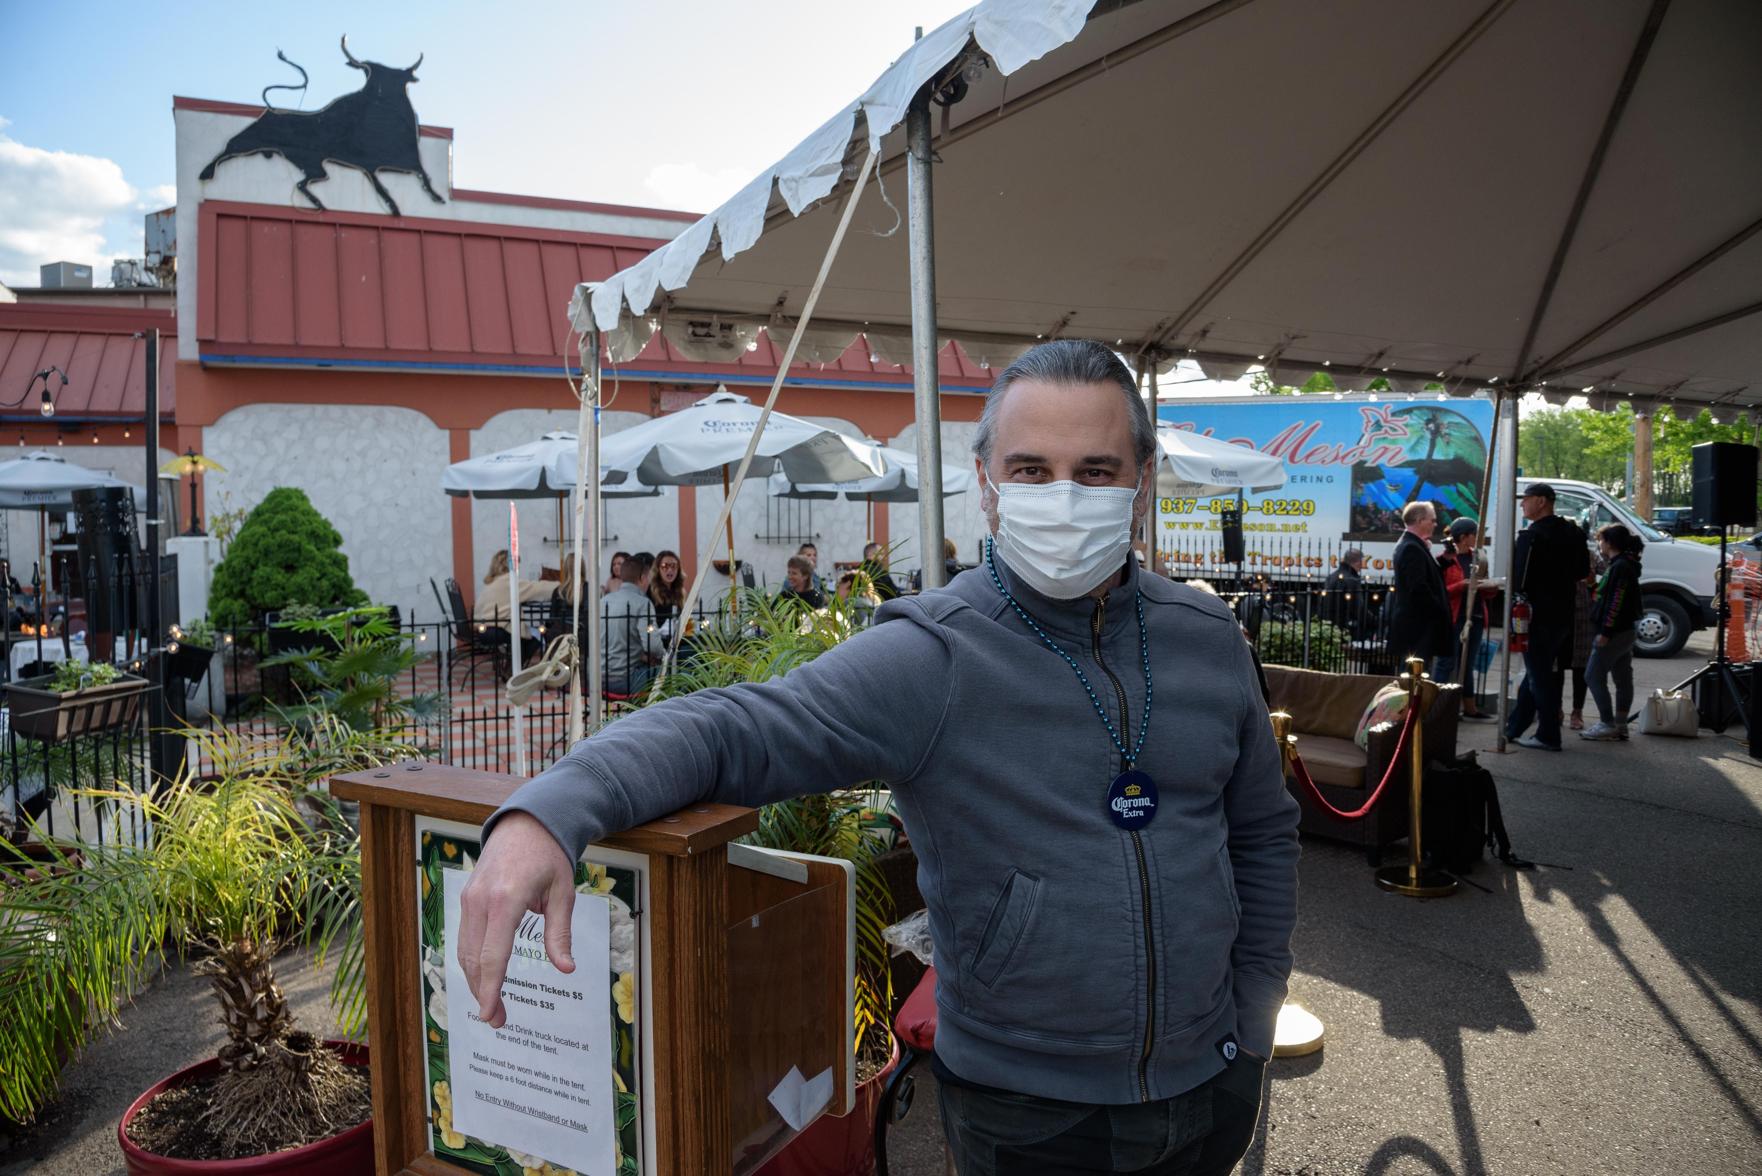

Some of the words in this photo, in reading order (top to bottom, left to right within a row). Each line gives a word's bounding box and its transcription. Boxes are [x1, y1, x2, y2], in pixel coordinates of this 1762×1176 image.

[1228, 420, 1409, 467] Meson
[1290, 474, 1335, 484] ERING
[1248, 551, 1323, 569] Tropics
[1111, 796, 1151, 812] Corona
[1122, 808, 1144, 818] Extra
[514, 945, 542, 960] MAYO
[503, 976, 538, 990] dmission
[539, 983, 571, 998] Tickets
[572, 991, 583, 1001] $5
[508, 992, 538, 1007] Tickets
[540, 1000, 555, 1011] $35
[496, 1031, 507, 1041] the
[508, 1035, 521, 1045] end
[522, 1039, 530, 1047] of
[531, 1040, 542, 1051] the
[543, 1044, 559, 1056] tent.
[515, 1024, 533, 1036] Drink
[535, 1031, 552, 1042] truck
[553, 1035, 580, 1049] located
[581, 1043, 589, 1052] at
[473, 1051, 490, 1061] Mask
[491, 1058, 506, 1068] must
[507, 1062, 516, 1071] be
[534, 1069, 551, 1081] while
[552, 1074, 559, 1082] in
[560, 1077, 570, 1087] the
[469, 1063, 489, 1076] Please
[490, 1070, 504, 1081] keep
[516, 1077, 527, 1088] foot
[528, 1081, 553, 1095] distance
[554, 1090, 570, 1101] while
[475, 1090, 484, 1099] No
[485, 1093, 502, 1106] Entry
[503, 1098, 527, 1113] Without
[528, 1106, 561, 1123] Wristband
[570, 1119, 588, 1132] Mask
